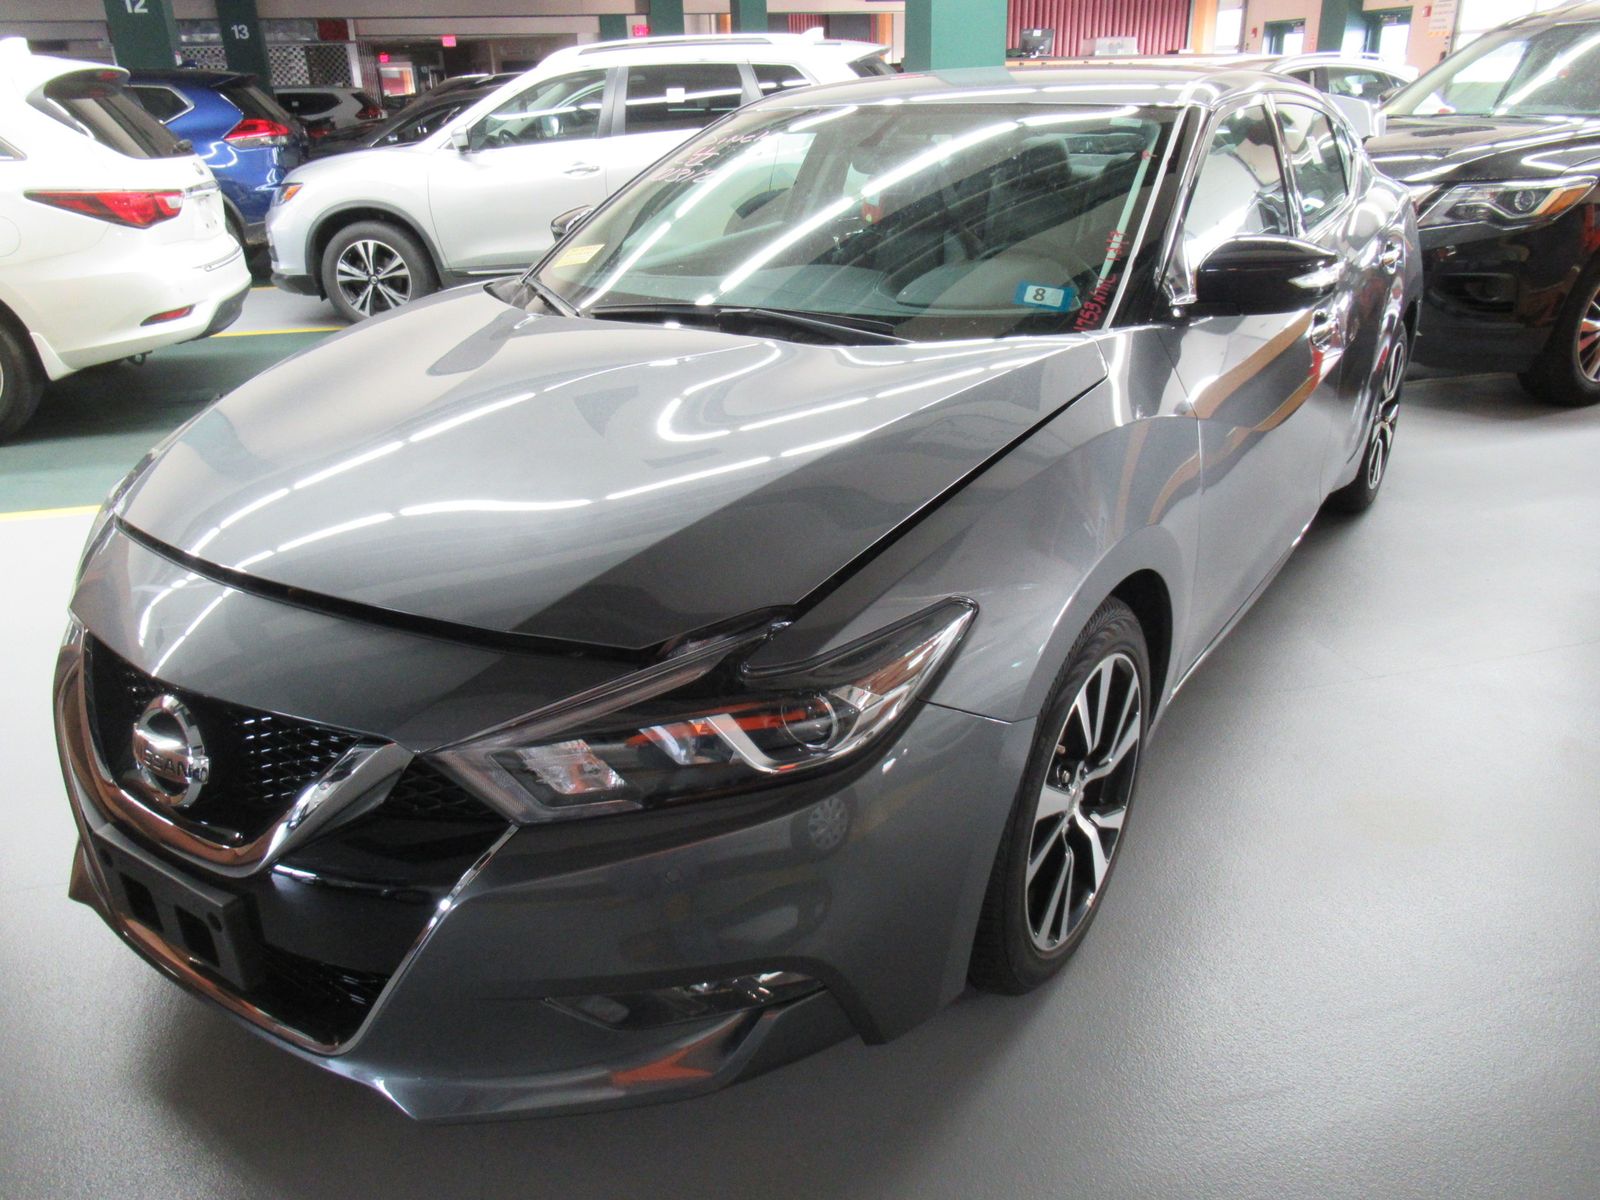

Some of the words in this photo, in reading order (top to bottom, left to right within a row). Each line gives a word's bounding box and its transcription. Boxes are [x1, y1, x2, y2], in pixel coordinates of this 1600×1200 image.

[124, 0, 148, 13] 12
[231, 24, 250, 40] 13
[1032, 287, 1046, 302] 8
